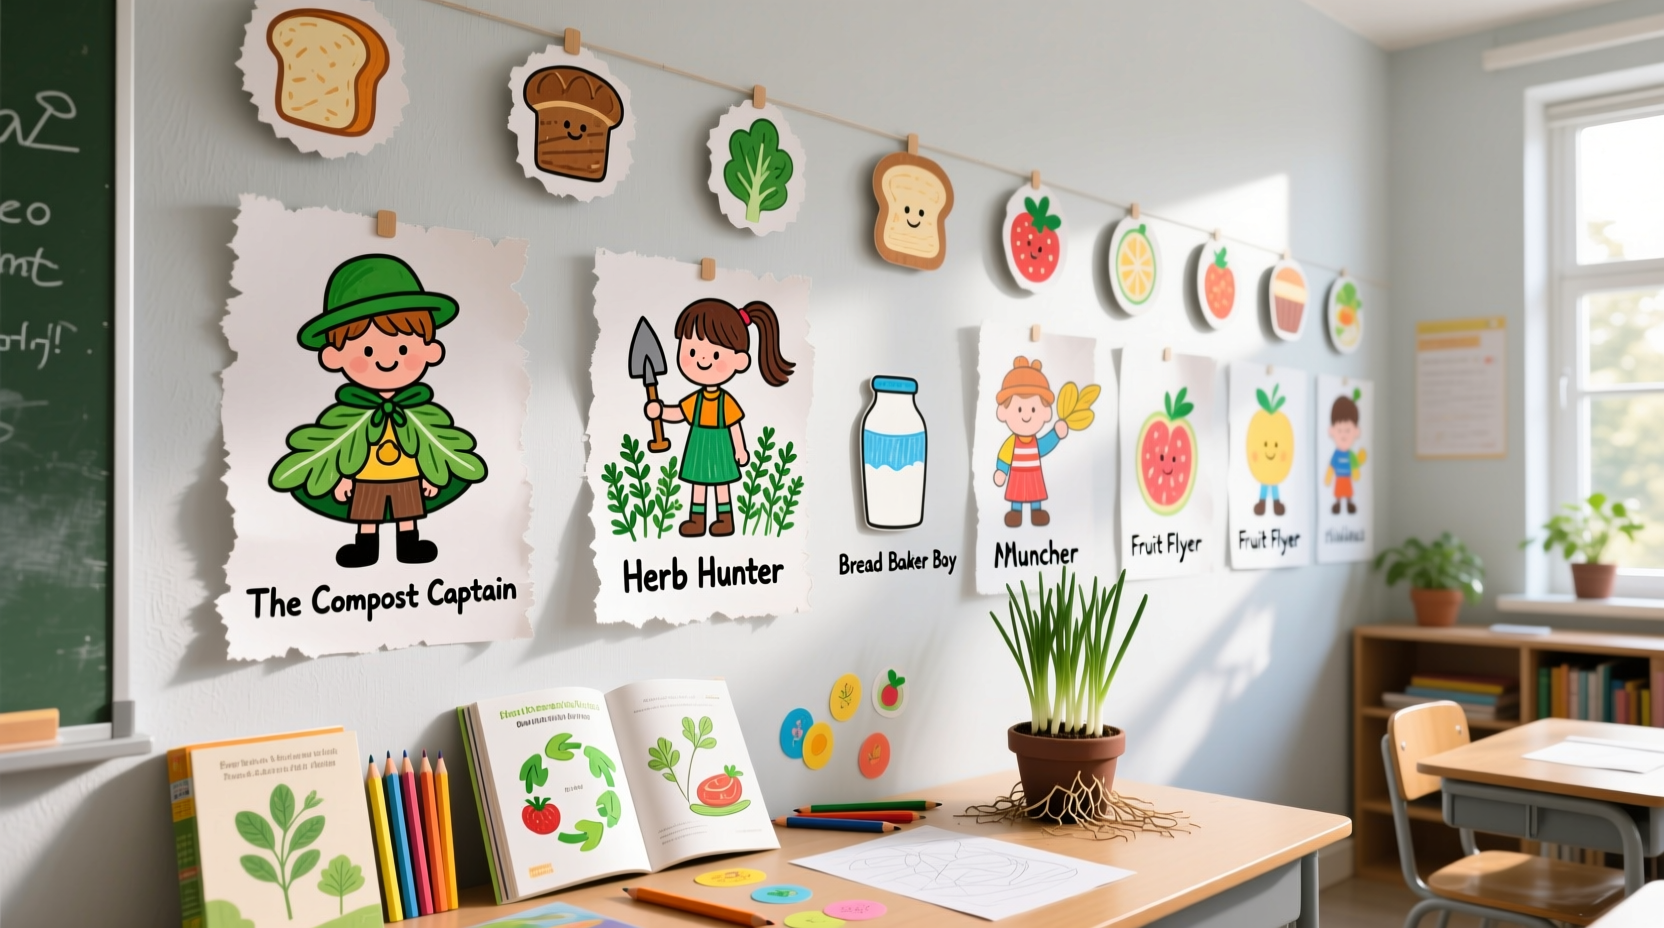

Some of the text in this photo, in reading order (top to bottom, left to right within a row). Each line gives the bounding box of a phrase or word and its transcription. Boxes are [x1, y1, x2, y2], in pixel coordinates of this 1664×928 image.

[1131, 532, 1202, 563] Fruit Flyer
[1239, 529, 1267, 550] Fruit
[1271, 528, 1301, 556] Flyer
[623, 555, 785, 594] Herb Hunter
[839, 548, 957, 576] Bread Baker Boy
[246, 576, 517, 622] The Compost Captain
